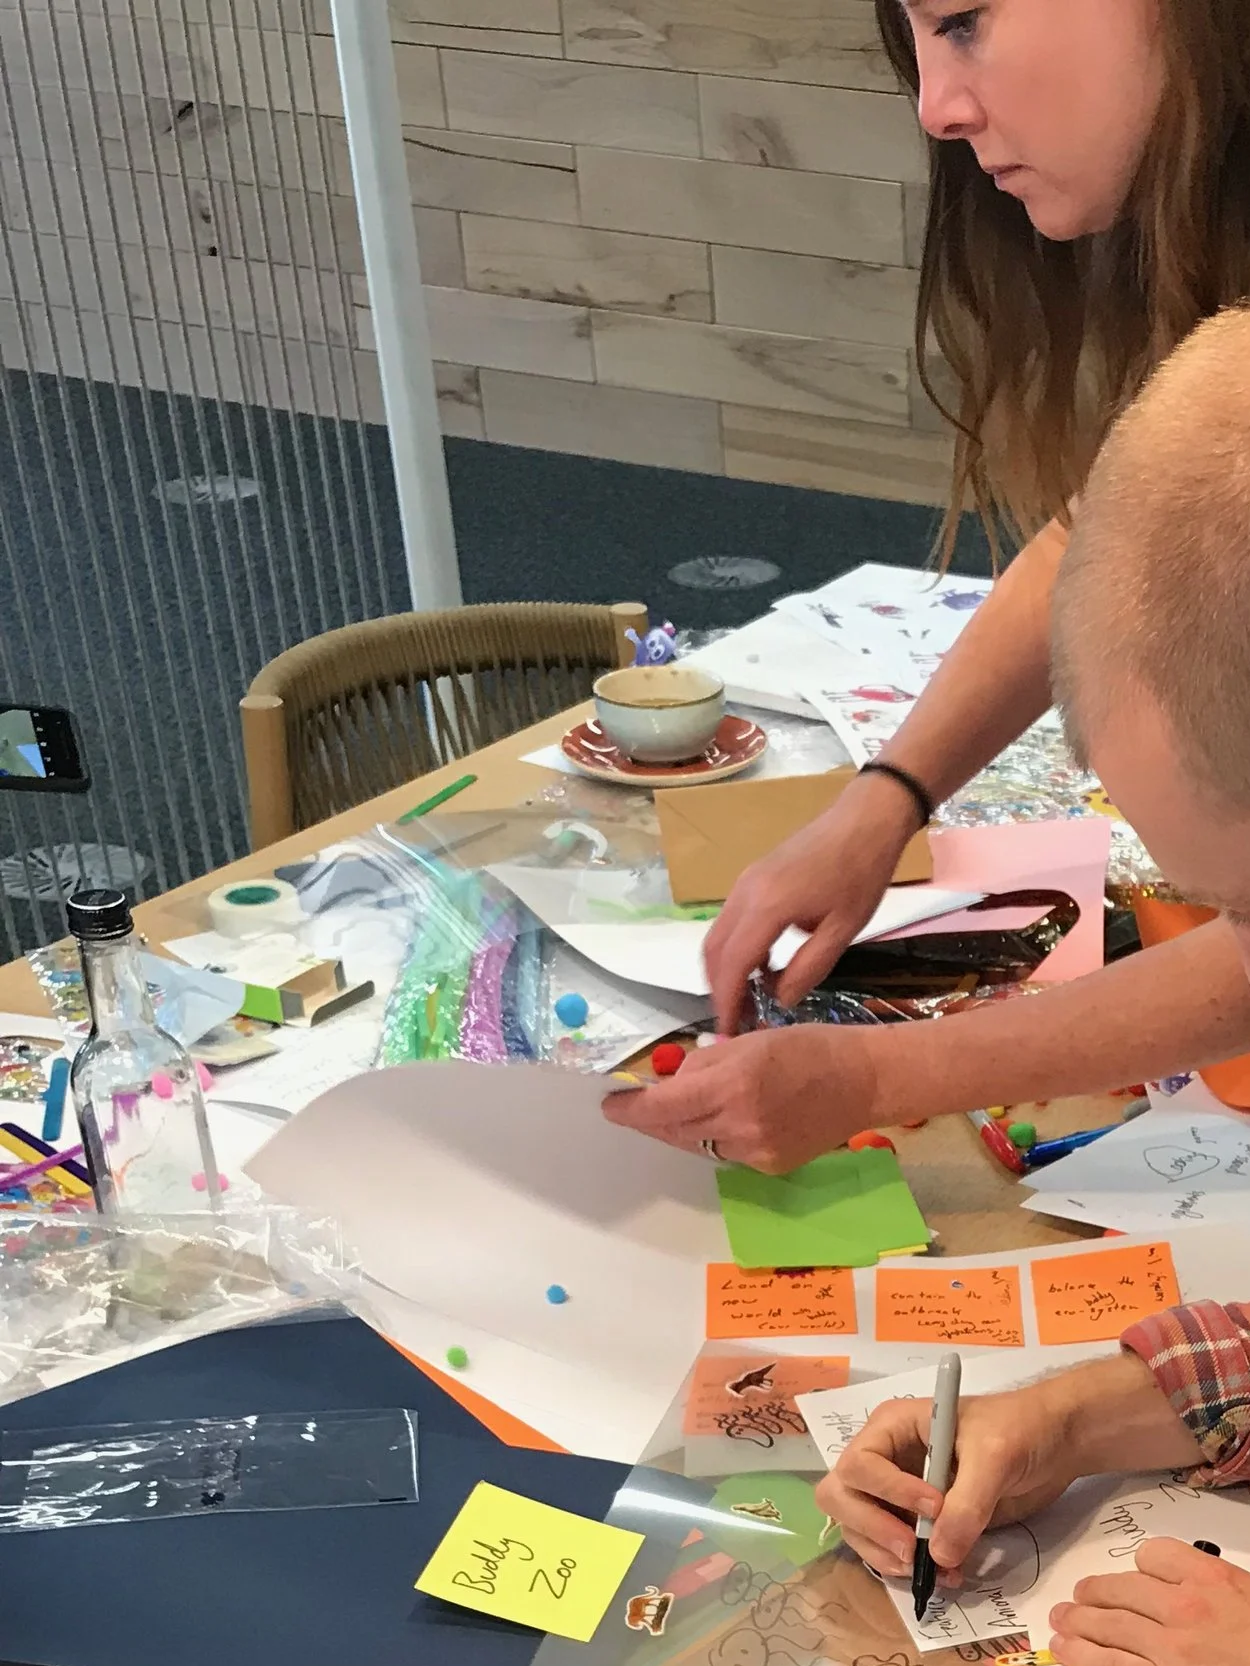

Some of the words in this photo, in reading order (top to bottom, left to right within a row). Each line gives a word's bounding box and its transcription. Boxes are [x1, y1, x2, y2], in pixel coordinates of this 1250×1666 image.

[731, 1308, 782, 1319] world
[452, 1536, 534, 1595] Buddy
[529, 1557, 577, 1599] Zoo
[978, 1586, 1027, 1628] Animal
